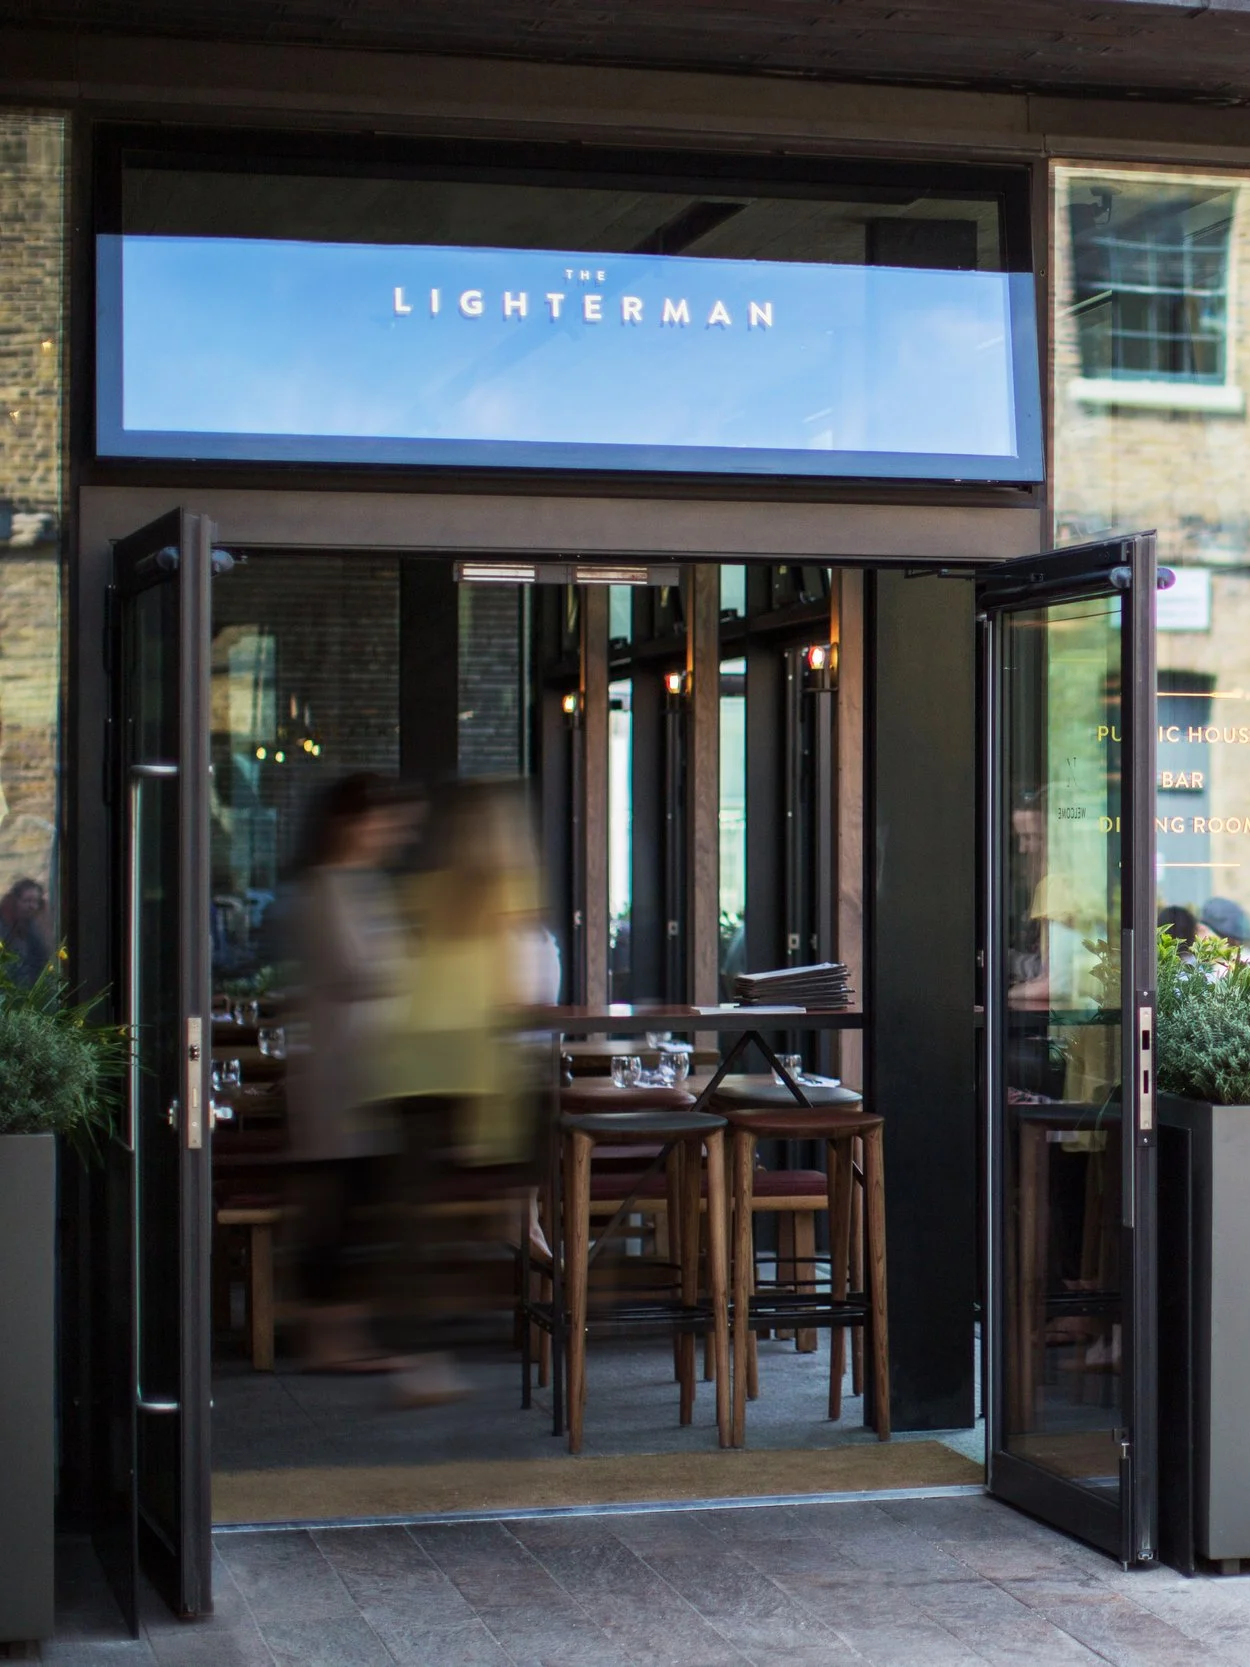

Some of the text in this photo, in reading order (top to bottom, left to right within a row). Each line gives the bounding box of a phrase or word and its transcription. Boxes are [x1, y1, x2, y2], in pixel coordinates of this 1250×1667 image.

[565, 269, 606, 281] THE
[393, 287, 773, 327] LIGHTERMAN
[1097, 725, 1180, 743] PUIC
[1162, 771, 1204, 788] BAR
[1099, 816, 1185, 834] DING
